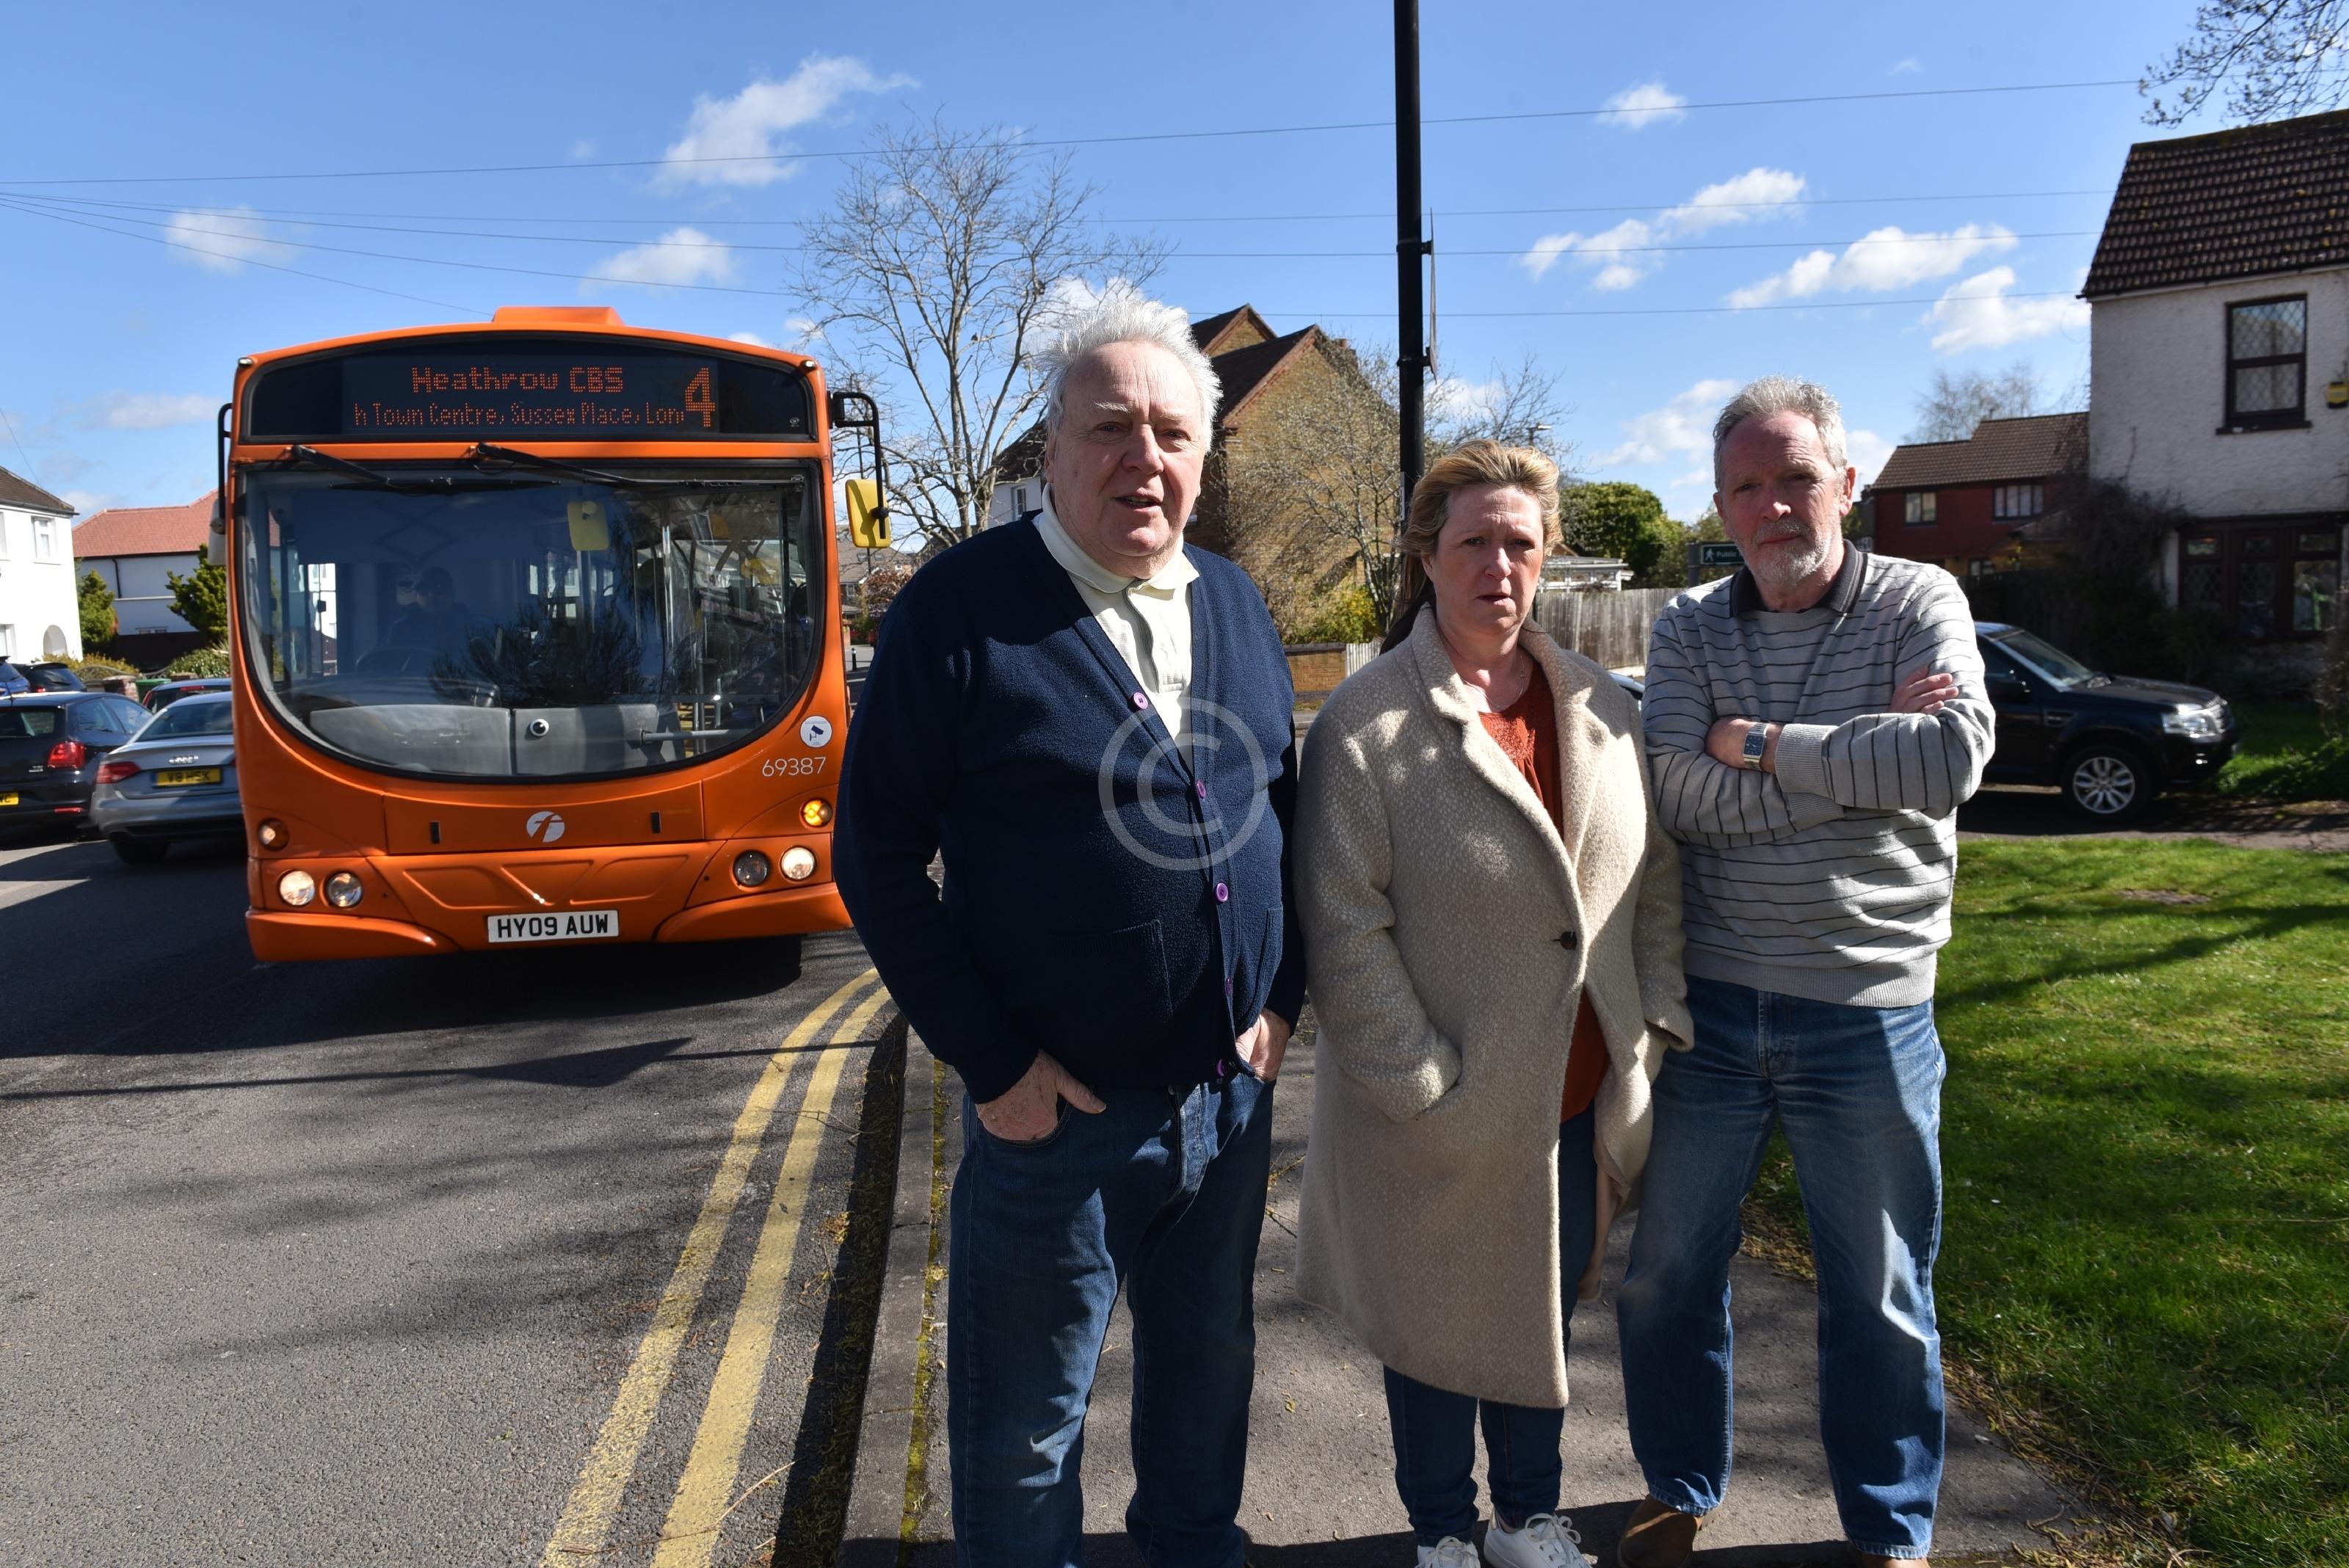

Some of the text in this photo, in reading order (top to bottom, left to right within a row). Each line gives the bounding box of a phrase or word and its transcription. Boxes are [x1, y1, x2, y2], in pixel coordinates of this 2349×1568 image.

[412, 366, 623, 393] Heathrow CBS
[685, 366, 716, 427] 4
[372, 403, 424, 426] Town
[429, 402, 505, 426] Centre,
[511, 402, 576, 425] Sussex
[581, 402, 640, 424] Place,
[762, 757, 827, 777] 69387
[497, 914, 609, 939] HY09 AUW
